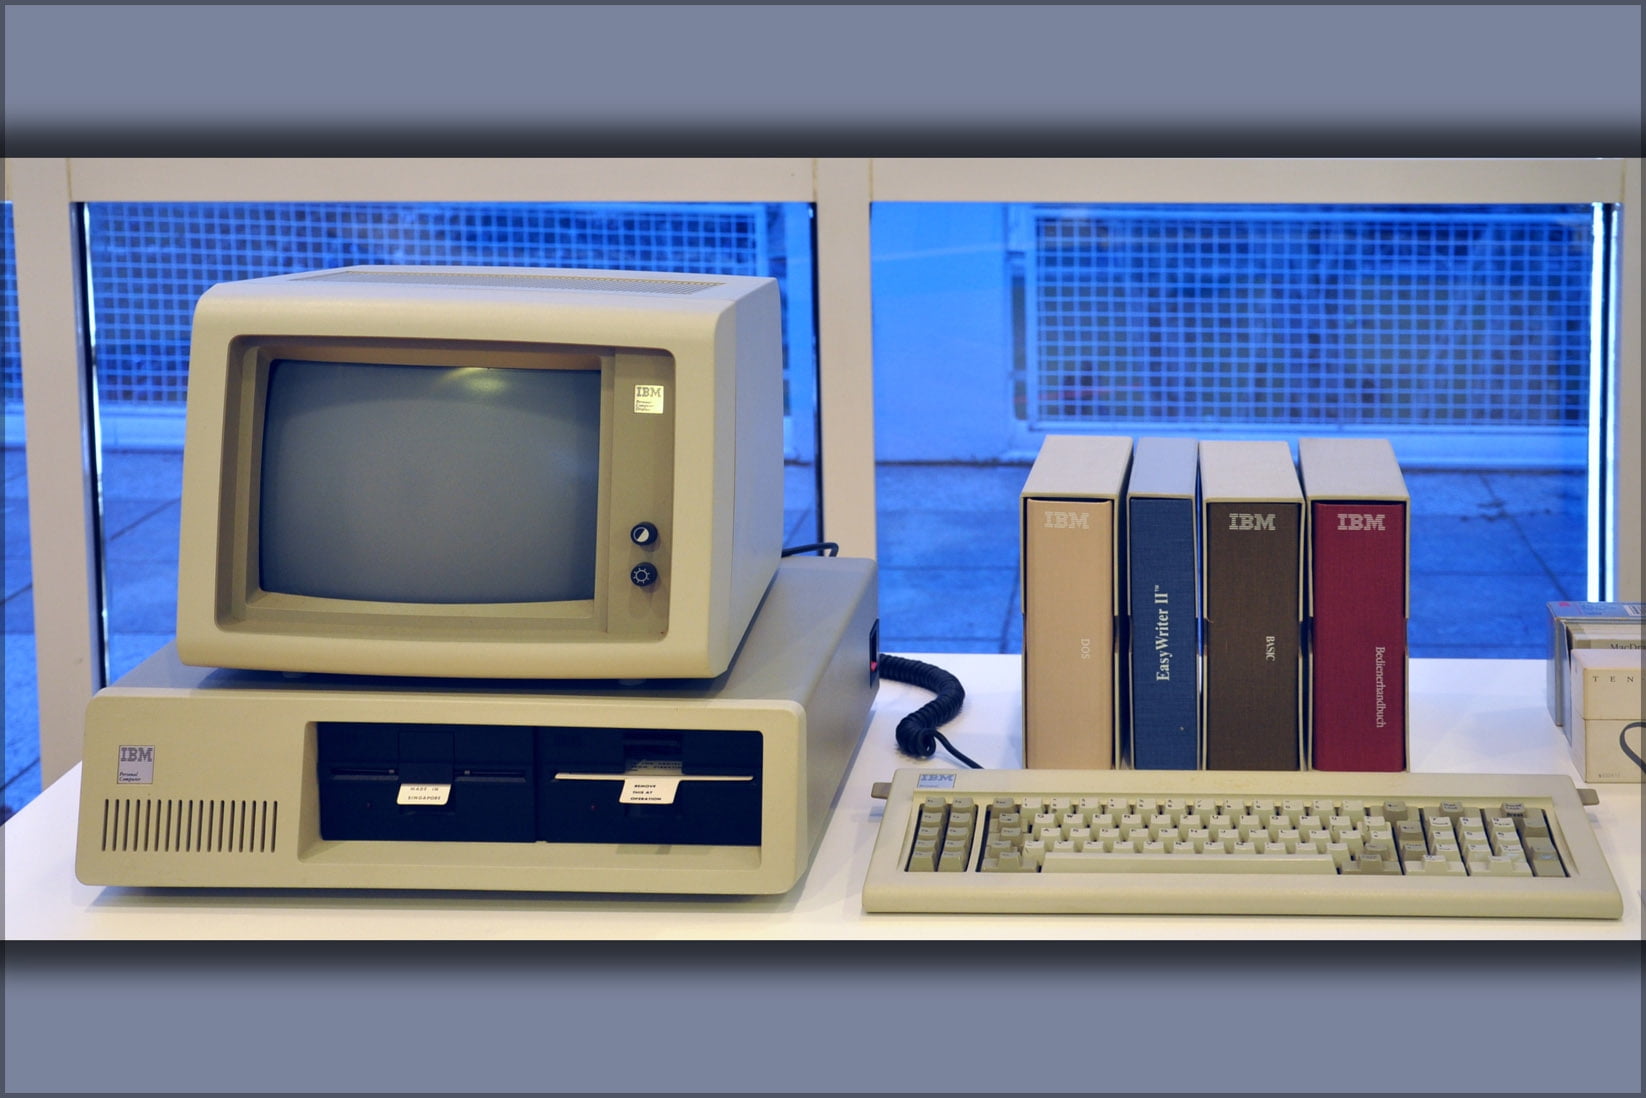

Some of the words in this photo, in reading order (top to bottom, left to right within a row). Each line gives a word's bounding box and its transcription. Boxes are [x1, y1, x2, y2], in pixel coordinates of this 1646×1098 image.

[636, 386, 662, 398] IBM
[1044, 511, 1089, 529] IBM
[1229, 513, 1276, 531] IBM
[1337, 513, 1386, 531] IBM
[1079, 638, 1091, 660] DOS
[1155, 608, 1173, 681] EasyWriter
[1265, 635, 1276, 662] BASIC
[1375, 646, 1387, 728] Bedienerhandbuch
[120, 747, 153, 762] IBM
